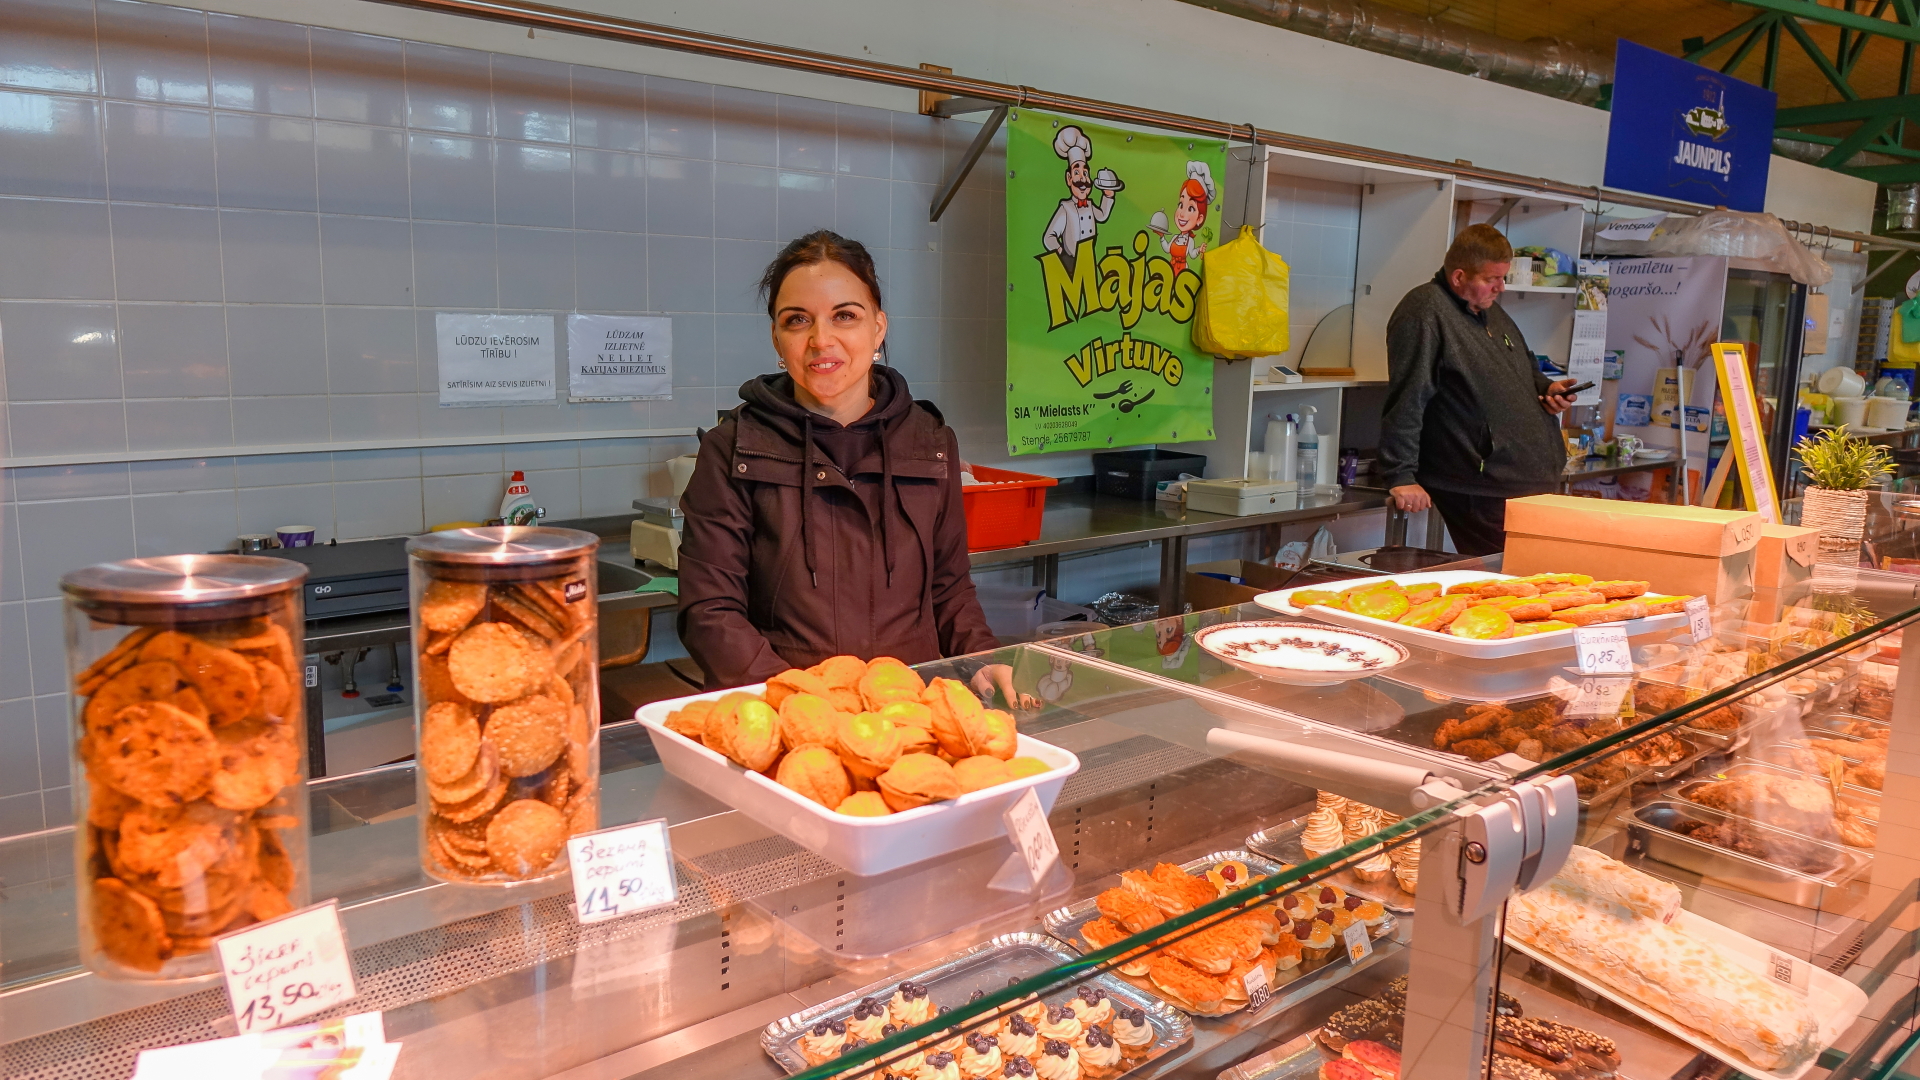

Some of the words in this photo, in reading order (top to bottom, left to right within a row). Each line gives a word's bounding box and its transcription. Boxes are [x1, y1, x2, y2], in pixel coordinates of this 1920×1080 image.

[1673, 140, 1731, 175] JAUNPILS
[1608, 222, 1657, 231] Ventspils
[1616, 261, 1674, 275] iemīlētu
[1033, 230, 1203, 333] Mājas
[605, 330, 644, 339] LŪDZAM
[455, 335, 487, 345] LŪDZU
[490, 335, 540, 345] IEVĒROSIM
[604, 342, 645, 351] IZLIETNĒ
[480, 348, 511, 358] TĪRĪBU
[1063, 332, 1184, 387] Virtuve
[581, 365, 618, 375] KAFIJAS
[620, 365, 666, 374] BIEZUMUS
[447, 380, 483, 388] SATĪRĪSIM
[485, 380, 497, 388] AIZ
[497, 380, 518, 388] SEVIS
[1014, 407, 1031, 419] SIA
[1021, 434, 1052, 446] Stende,
[1053, 431, 1091, 444] 25679787
